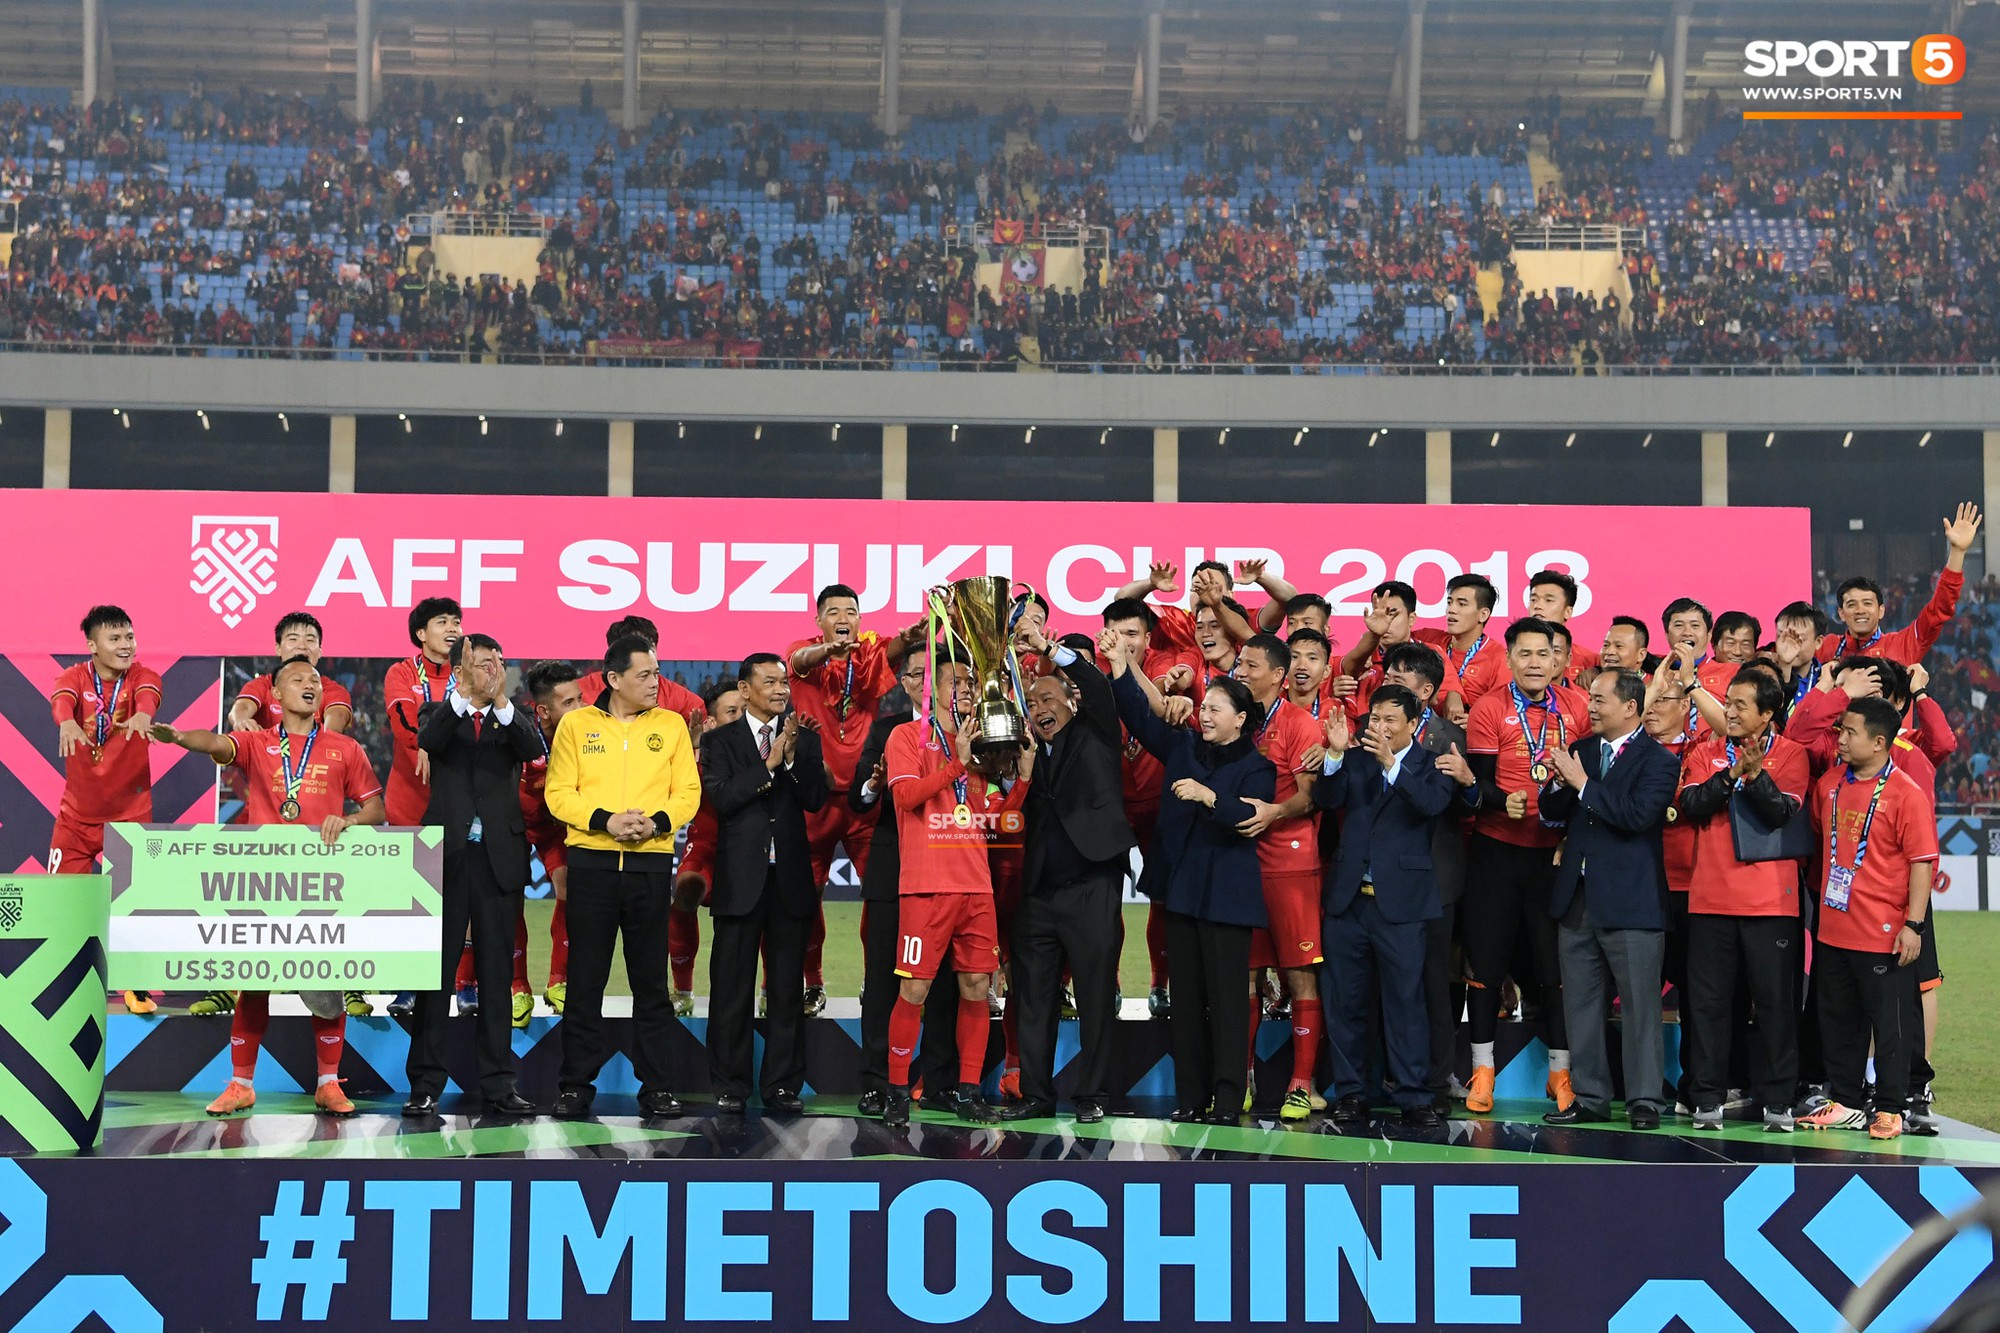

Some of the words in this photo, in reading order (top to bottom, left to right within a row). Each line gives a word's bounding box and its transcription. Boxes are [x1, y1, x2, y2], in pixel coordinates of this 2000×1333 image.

[305, 537, 524, 608] AFF
[1046, 544, 1285, 616] CUP
[1319, 548, 1593, 619] 2018
[582, 745, 606, 754] DHMA
[167, 843, 207, 855] AFF
[212, 842, 296, 856] SUZUKI
[301, 843, 345, 856] CUP
[351, 844, 401, 857] 2018
[200, 872, 345, 902] WINNER
[197, 923, 346, 945] VIETNAM
[903, 935, 922, 965] 10
[165, 959, 376, 983] US$300,000.00
[251, 1179, 1522, 1325] #TIMETOSHINE
